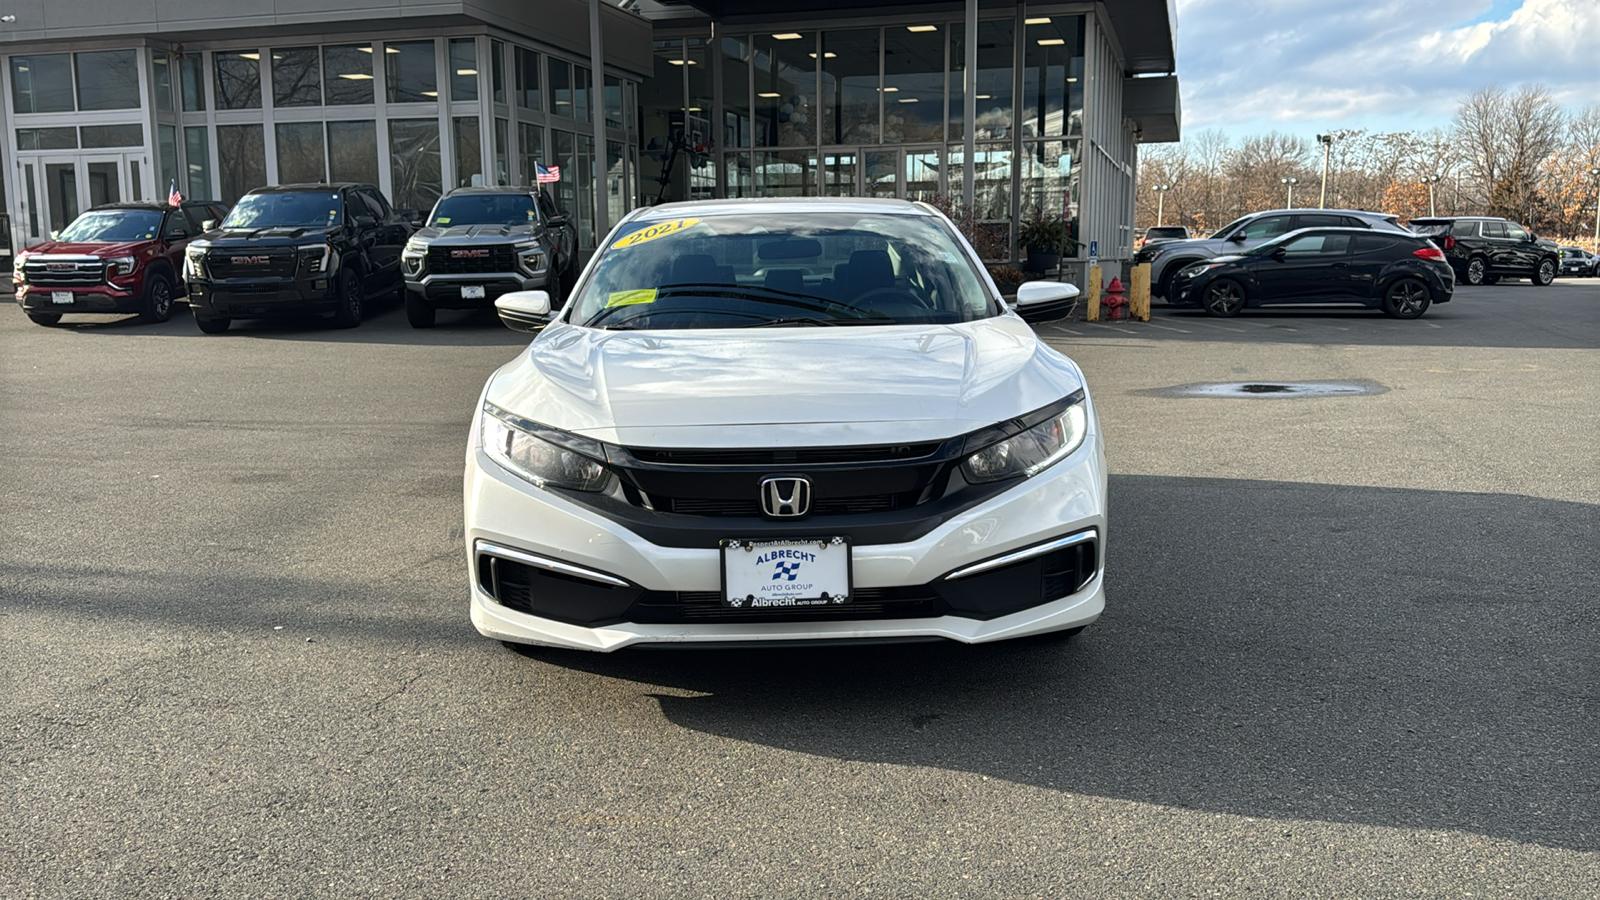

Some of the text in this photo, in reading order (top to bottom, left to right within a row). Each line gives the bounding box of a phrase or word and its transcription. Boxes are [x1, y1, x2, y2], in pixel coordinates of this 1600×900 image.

[629, 221, 685, 244] 2021
[450, 249, 490, 258] GMC
[230, 255, 270, 264] GMC
[748, 538, 823, 548] RespectAtAlbrecht.com
[756, 549, 816, 566] ALBRECHT
[761, 583, 813, 592] AUTO GROUP
[751, 597, 796, 607] Albrecht
